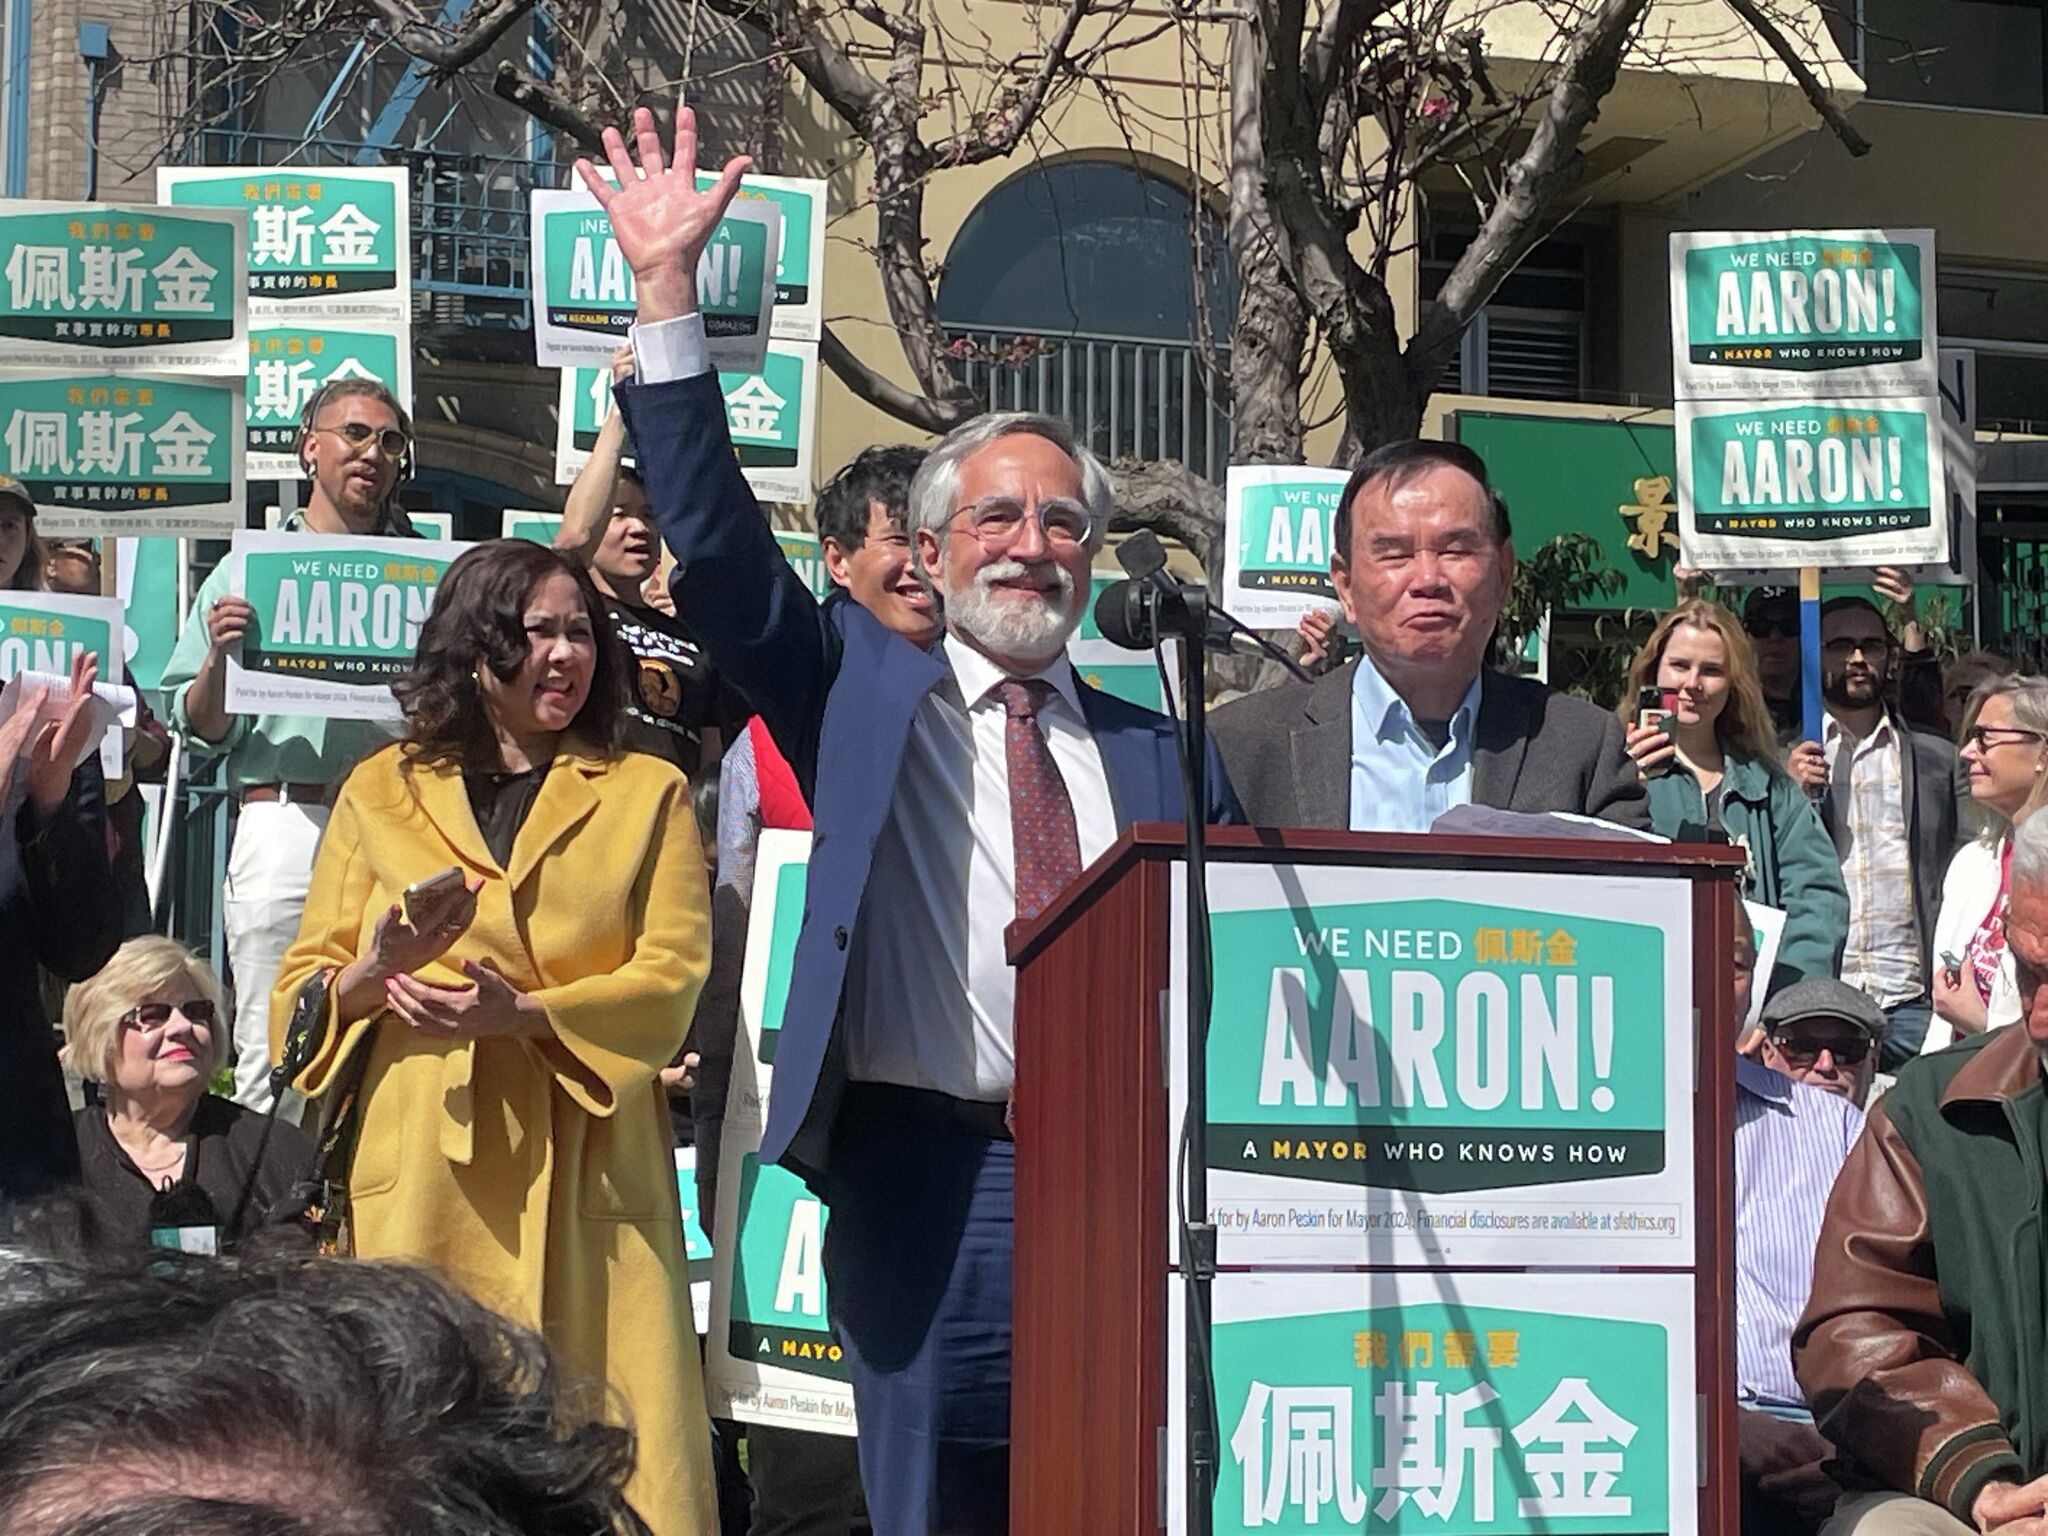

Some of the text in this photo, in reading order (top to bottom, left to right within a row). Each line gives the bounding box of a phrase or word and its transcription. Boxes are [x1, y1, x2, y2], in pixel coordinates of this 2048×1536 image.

[248, 203, 382, 266] 斯金
[1730, 252, 1759, 267] WE
[1766, 251, 1816, 266] NEED
[5, 244, 218, 312] 佩斯金
[1716, 268, 1896, 336] AARON!
[1710, 351, 1718, 360] A
[1724, 349, 1773, 360] MAYOR
[1779, 348, 1811, 359] WHO
[1735, 421, 1764, 435] WE
[1771, 419, 1821, 434] NEED
[4, 409, 217, 476] 佩斯金
[1722, 437, 1904, 505] AARON!
[1284, 491, 1341, 507] WE NE
[1715, 520, 1722, 529] A
[1728, 518, 1777, 529] MAYOR
[1784, 518, 1815, 528] WHO
[1822, 516, 1873, 527] KNOWS
[292, 560, 322, 576] WE
[328, 563, 379, 580] NEED
[1257, 576, 1265, 585] A
[1271, 575, 1318, 585] MAYOR
[271, 579, 437, 650] AARON
[263, 658, 414, 673] A MAYOR WHO KNOW
[1294, 927, 1578, 965] WE NEED 佩斯金
[1259, 968, 1615, 1112] AARON!
[1243, 1140, 1627, 1163] A MAYOR WHO KNOWS HOW
[1217, 1207, 1232, 1227] for
[1236, 1208, 1249, 1232] by
[1252, 1208, 1285, 1227] Aaron
[1289, 1208, 1324, 1228] Peskin
[1327, 1208, 1342, 1228] for
[1346, 1208, 1380, 1233] Mayor
[1417, 1209, 1467, 1229] Financial
[1469, 1210, 1530, 1230] disclosures
[1531, 1213, 1549, 1229] are
[1551, 1211, 1598, 1230] available
[1600, 1212, 1611, 1229] at
[1613, 1211, 1676, 1234] sfethics.org
[759, 1337, 843, 1362] A MAYO
[835, 1400, 854, 1423] May
[1230, 1377, 1640, 1528] 佩斯金
